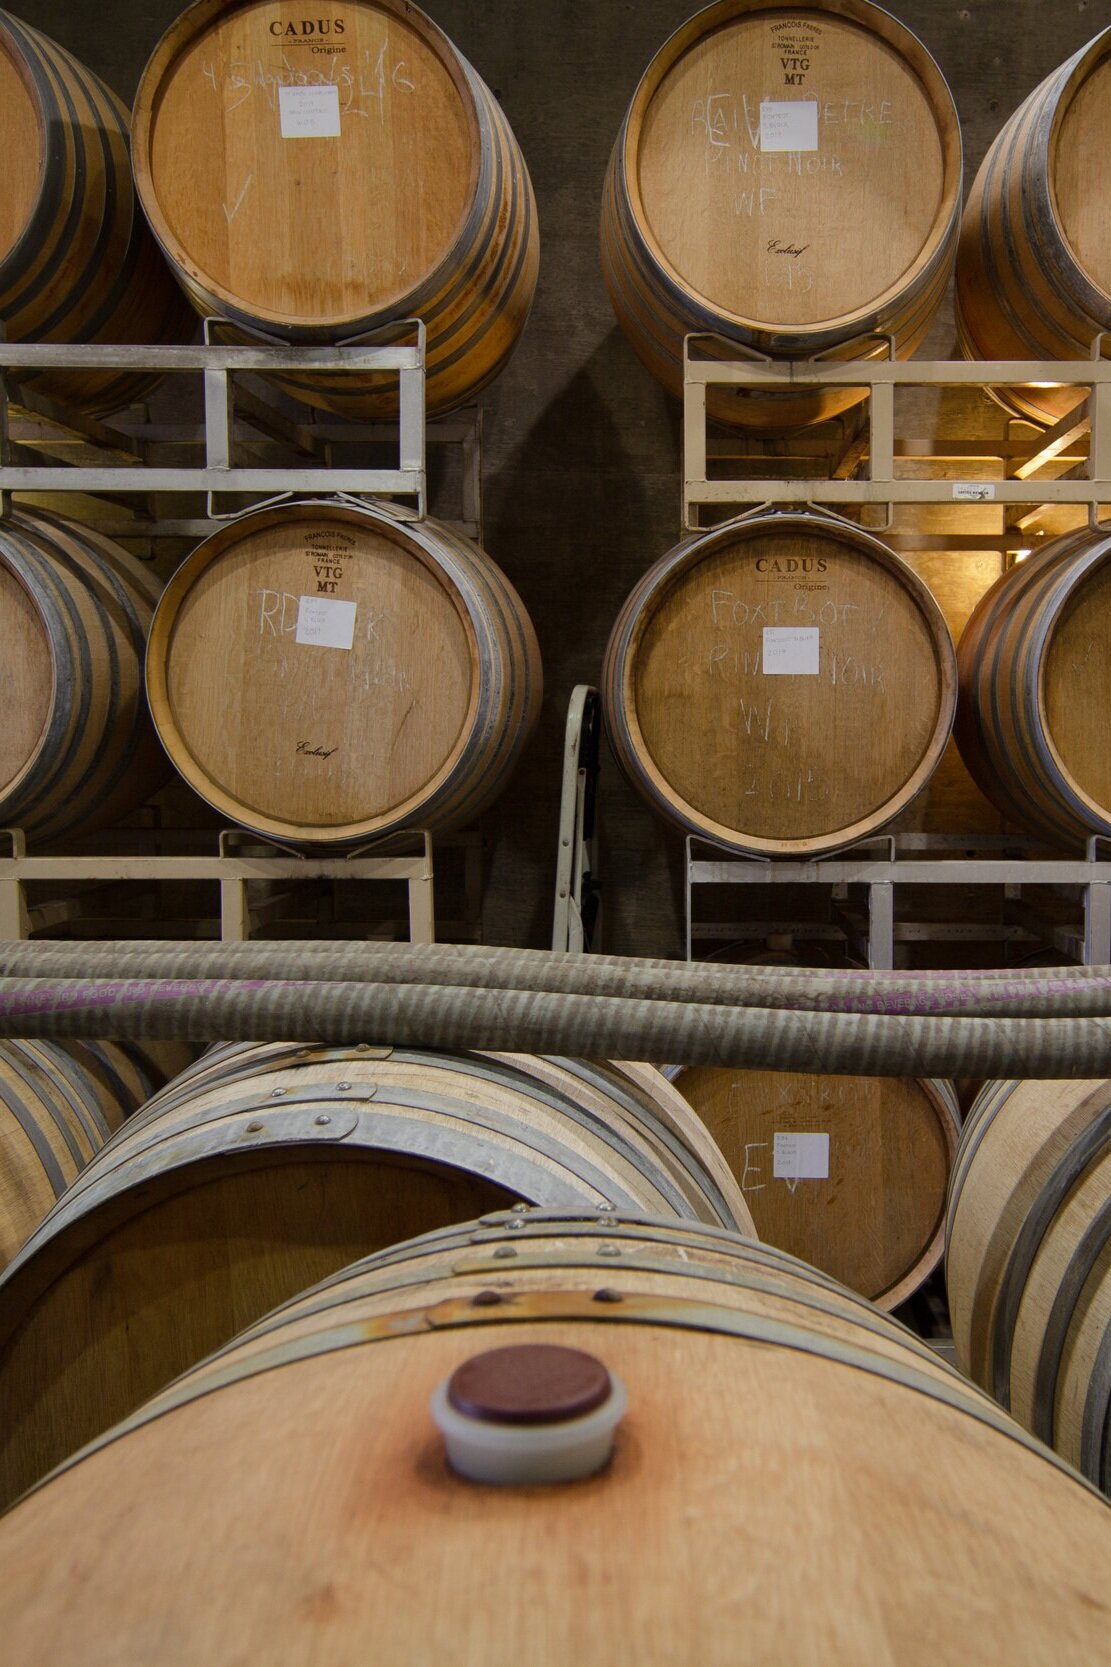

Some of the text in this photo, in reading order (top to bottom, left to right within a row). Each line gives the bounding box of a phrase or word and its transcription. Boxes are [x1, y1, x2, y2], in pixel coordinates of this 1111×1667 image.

[269, 18, 345, 36] CADUS
[311, 46, 347, 55] Origine
[780, 57, 811, 71] VTG
[784, 73, 806, 86] MT
[317, 557, 341, 565] FRANCE
[755, 558, 828, 573] CADUS
[313, 565, 344, 579] VTG
[316, 580, 339, 594] MT
